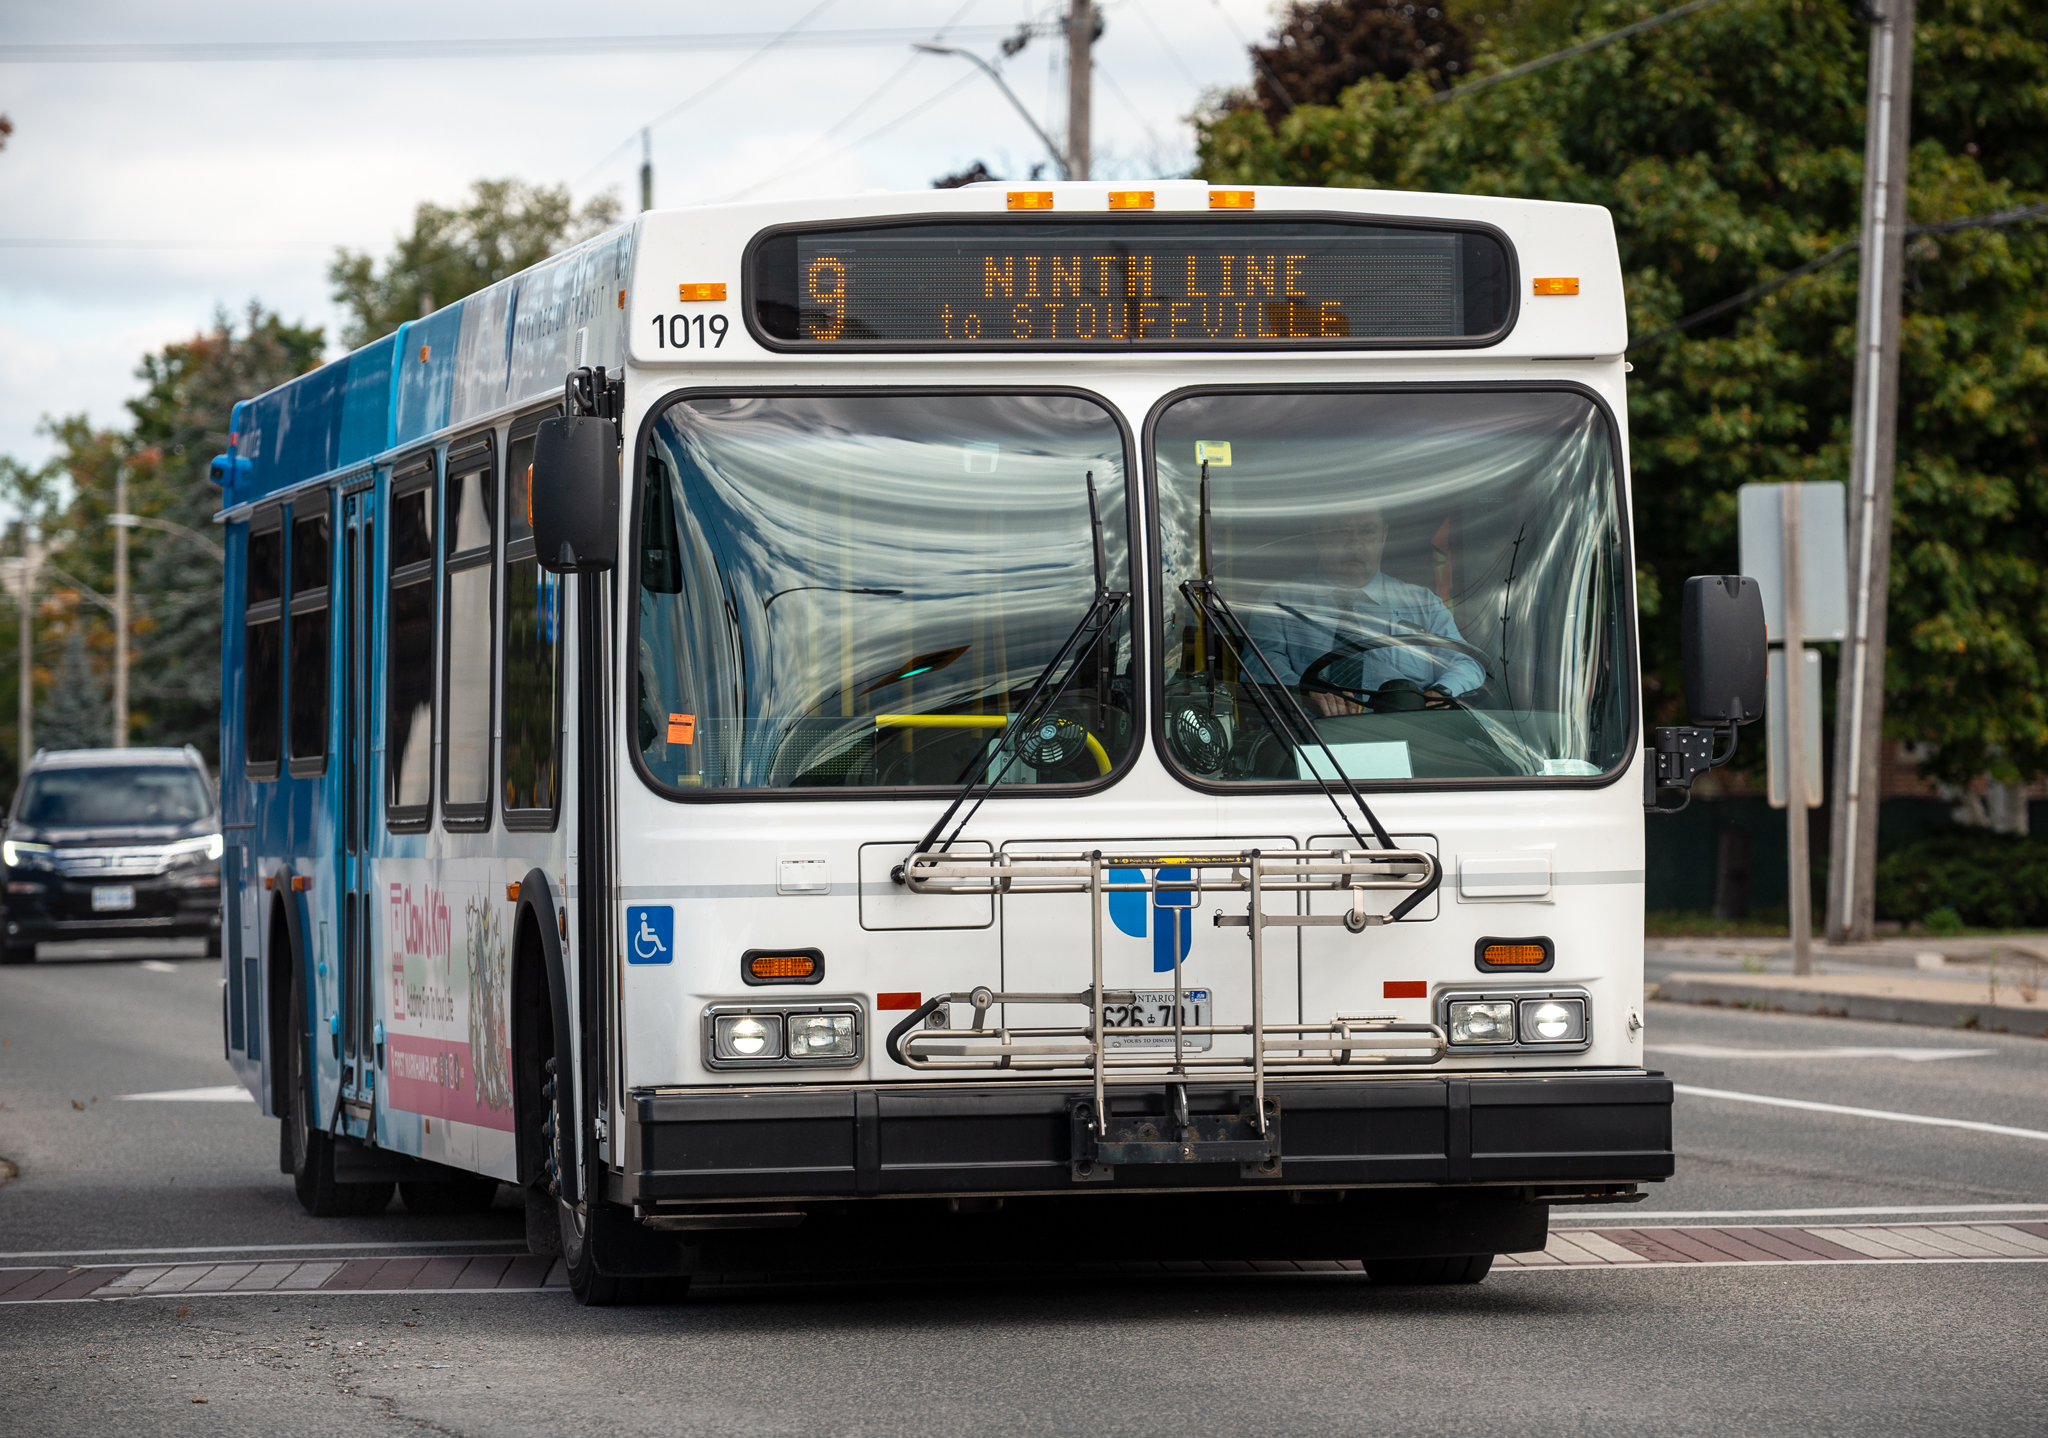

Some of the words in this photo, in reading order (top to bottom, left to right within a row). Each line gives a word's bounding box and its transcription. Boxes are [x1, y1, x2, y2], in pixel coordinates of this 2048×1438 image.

[984, 255, 1152, 297] NINTH
[1187, 254, 1306, 296] LINE
[538, 300, 567, 339] REGION
[568, 285, 605, 327] TRANSIT
[809, 256, 845, 340] 9
[652, 313, 729, 349] 1019
[940, 303, 981, 339] to
[1012, 301, 1341, 339] STOUFFVILLE
[404, 883, 424, 955] Claw
[424, 883, 431, 959] &
[431, 888, 452, 976] Kitty
[406, 983, 422, 1028] Adding
[422, 986, 430, 1019] Fun
[435, 987, 445, 1021] Your
[445, 986, 454, 1022] Life
[1135, 994, 1175, 1004] NTARIO
[394, 1050, 405, 1077] FIRST
[425, 1056, 438, 1083] PLACE
